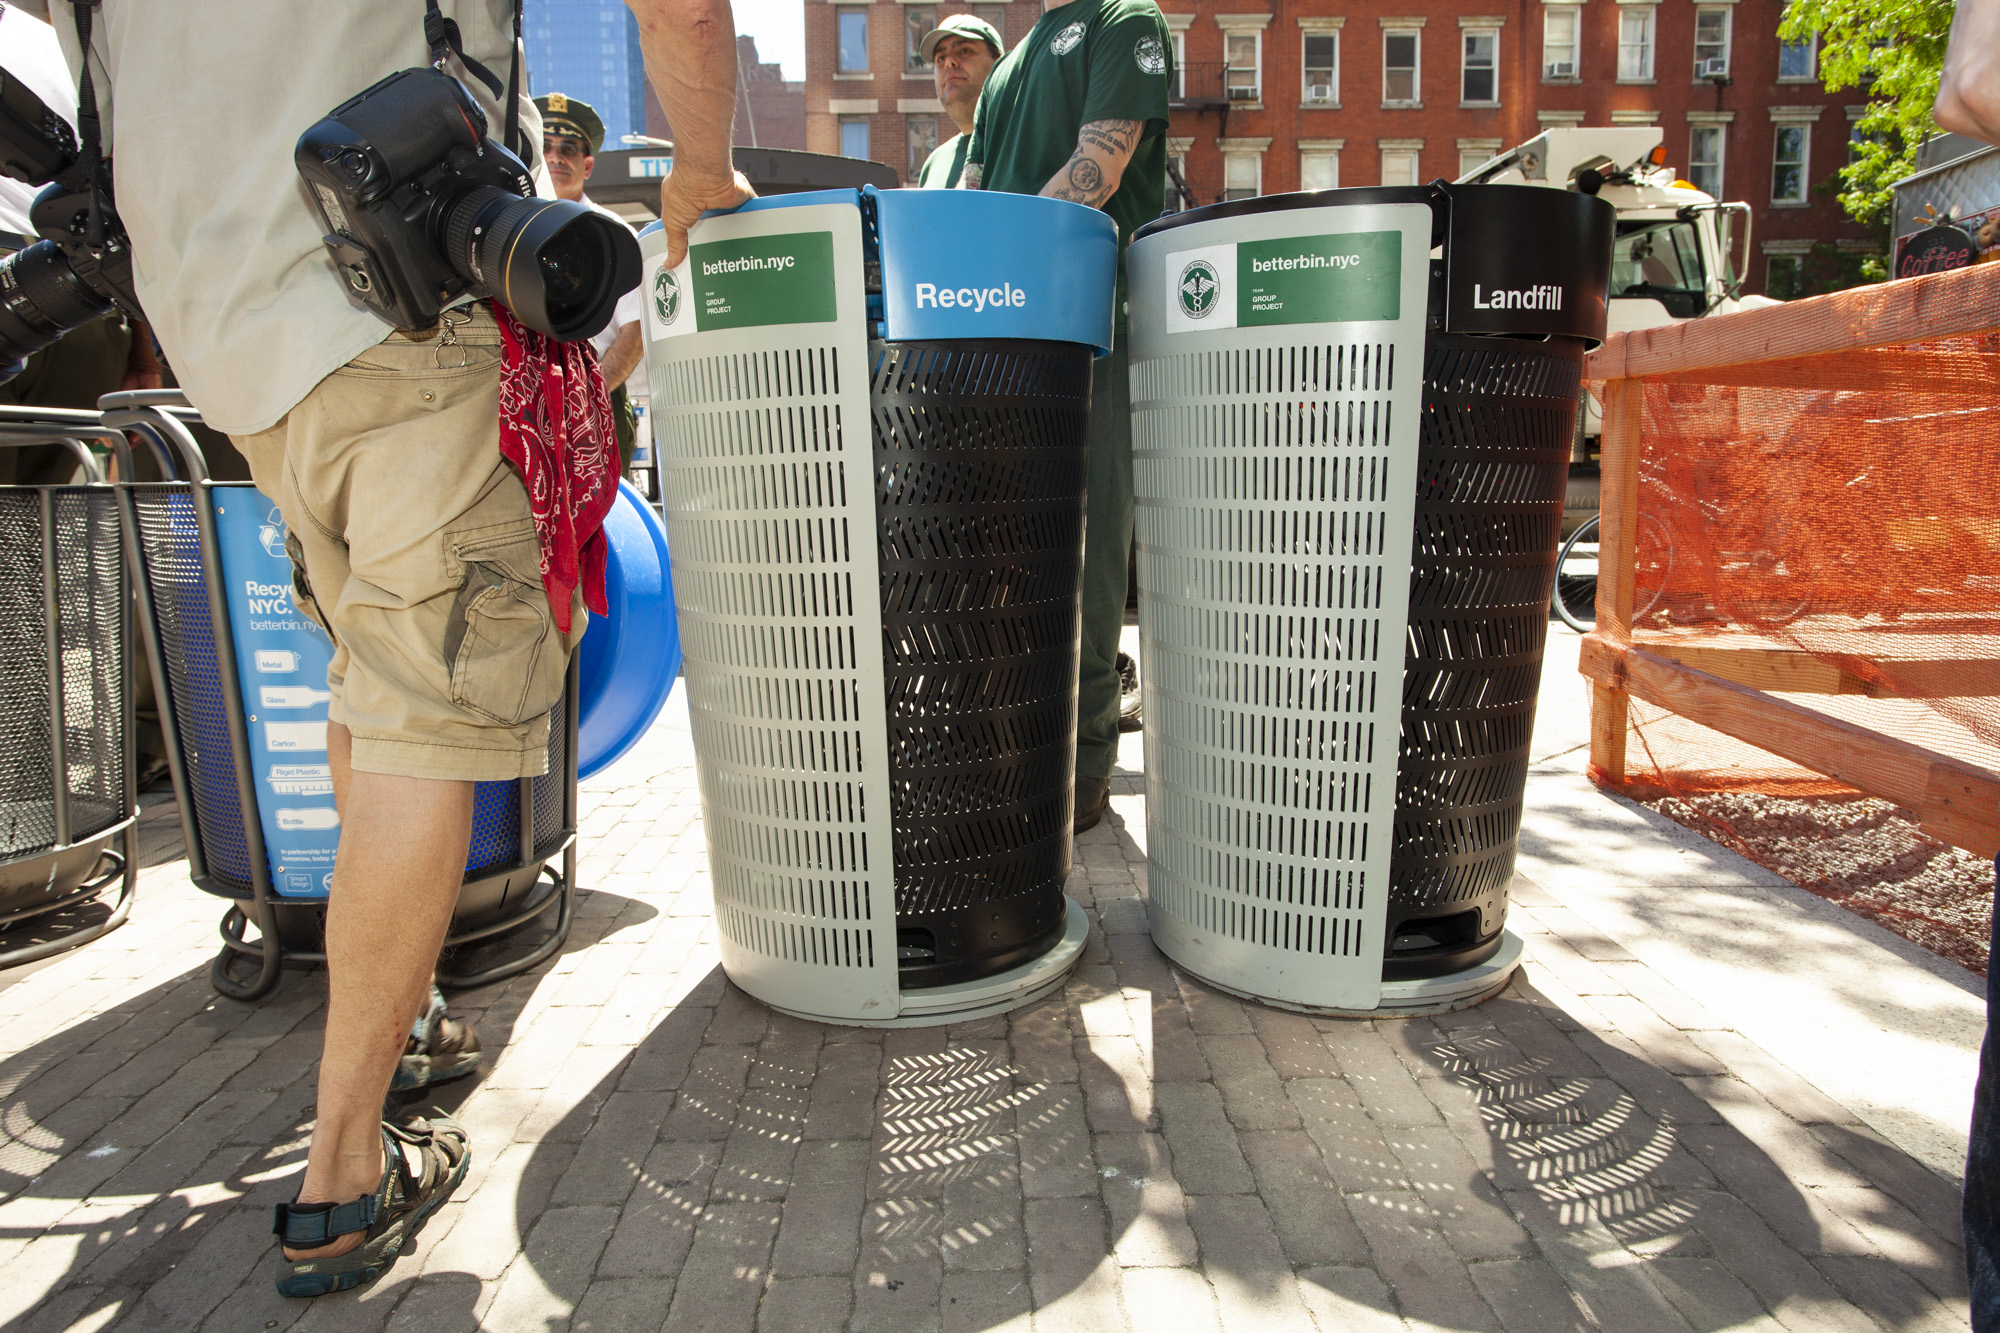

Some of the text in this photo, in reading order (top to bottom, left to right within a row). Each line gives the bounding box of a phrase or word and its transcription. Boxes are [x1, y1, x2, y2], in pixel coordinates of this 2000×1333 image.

[702, 255, 795, 276] betterbin.nyc
[1252, 253, 1360, 273] betterbin.nyc
[1901, 246, 1969, 278] Coffee
[1203, 263, 1213, 272] CITY
[706, 298, 725, 306] GROUP
[916, 282, 1026, 313] Recycle
[1252, 295, 1277, 303] GROUP
[1474, 284, 1562, 310] Landfill
[707, 305, 731, 315] PROJECT
[1252, 303, 1283, 311] PROJECT
[249, 599, 293, 614] NYC.
[266, 696, 286, 704] Glass
[276, 768, 295, 777] Rigid
